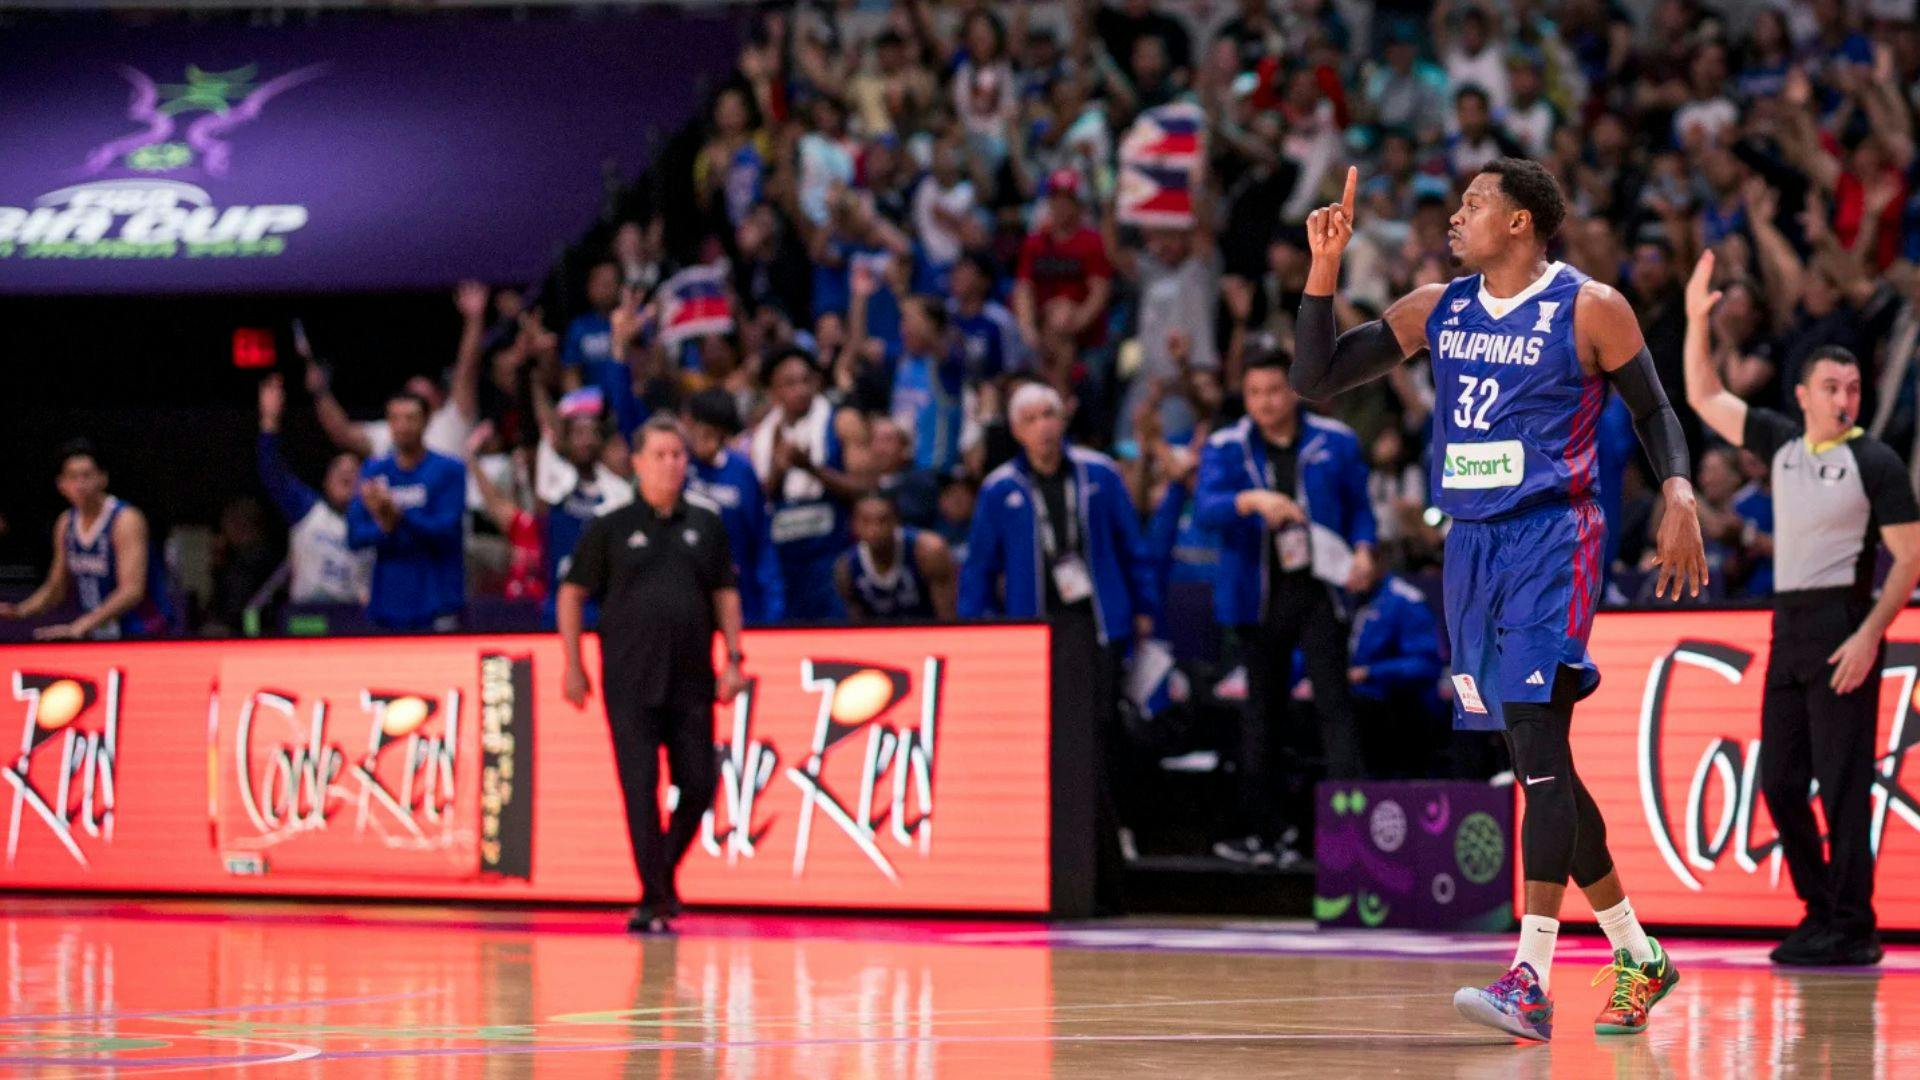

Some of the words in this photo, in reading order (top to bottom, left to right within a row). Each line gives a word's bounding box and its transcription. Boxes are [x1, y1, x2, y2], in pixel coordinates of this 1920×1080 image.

[1438, 330, 1544, 366] PILIPINAS
[1453, 374, 1501, 430] 32
[1455, 453, 1512, 477] Smart
[236, 690, 342, 833] Code
[351, 686, 461, 846] Red
[700, 678, 777, 866] de
[786, 655, 946, 887] Red
